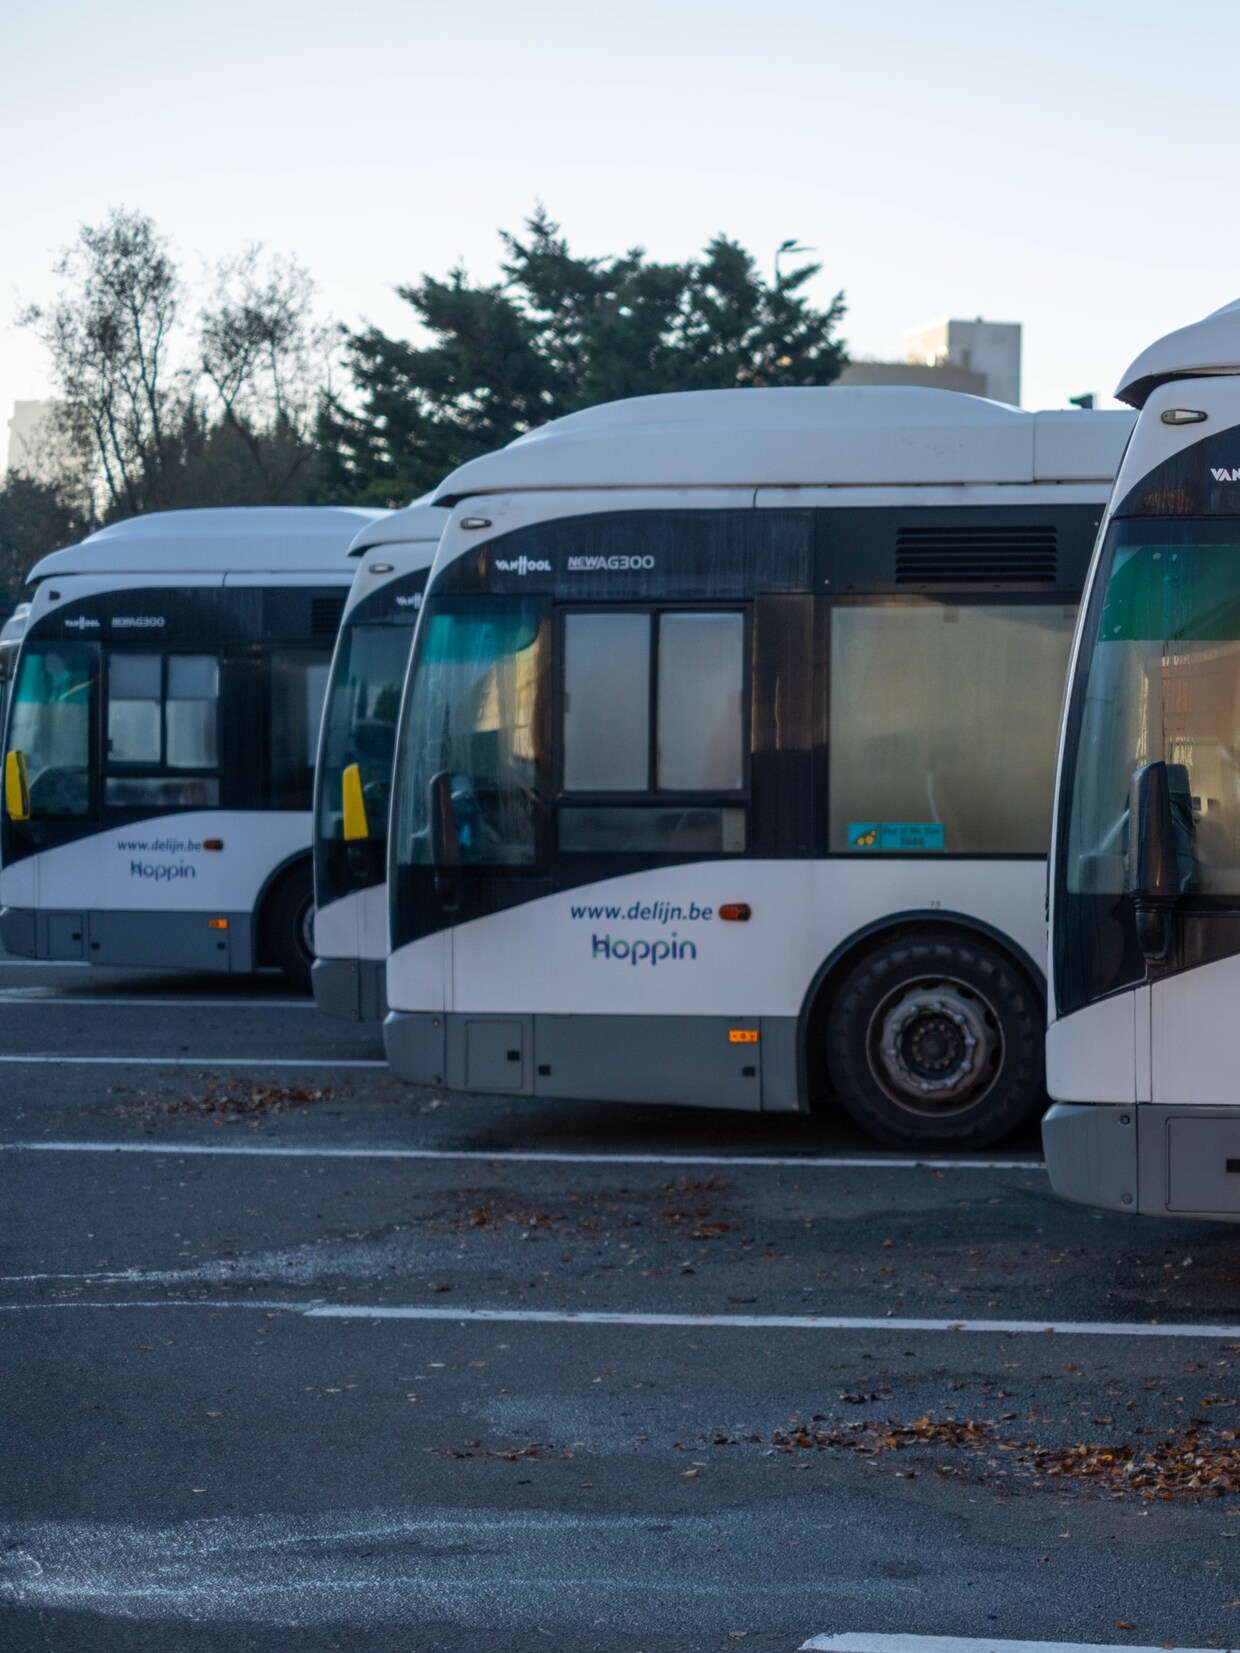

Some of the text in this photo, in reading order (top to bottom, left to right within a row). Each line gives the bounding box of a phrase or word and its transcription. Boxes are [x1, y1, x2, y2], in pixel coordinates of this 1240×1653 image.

[495, 555, 552, 576] VANHOOL
[117, 839, 201, 855] www.delijn.be
[130, 860, 196, 882] Hoppin
[570, 901, 713, 924] www.delijn.be
[591, 931, 697, 966] Hoppin
